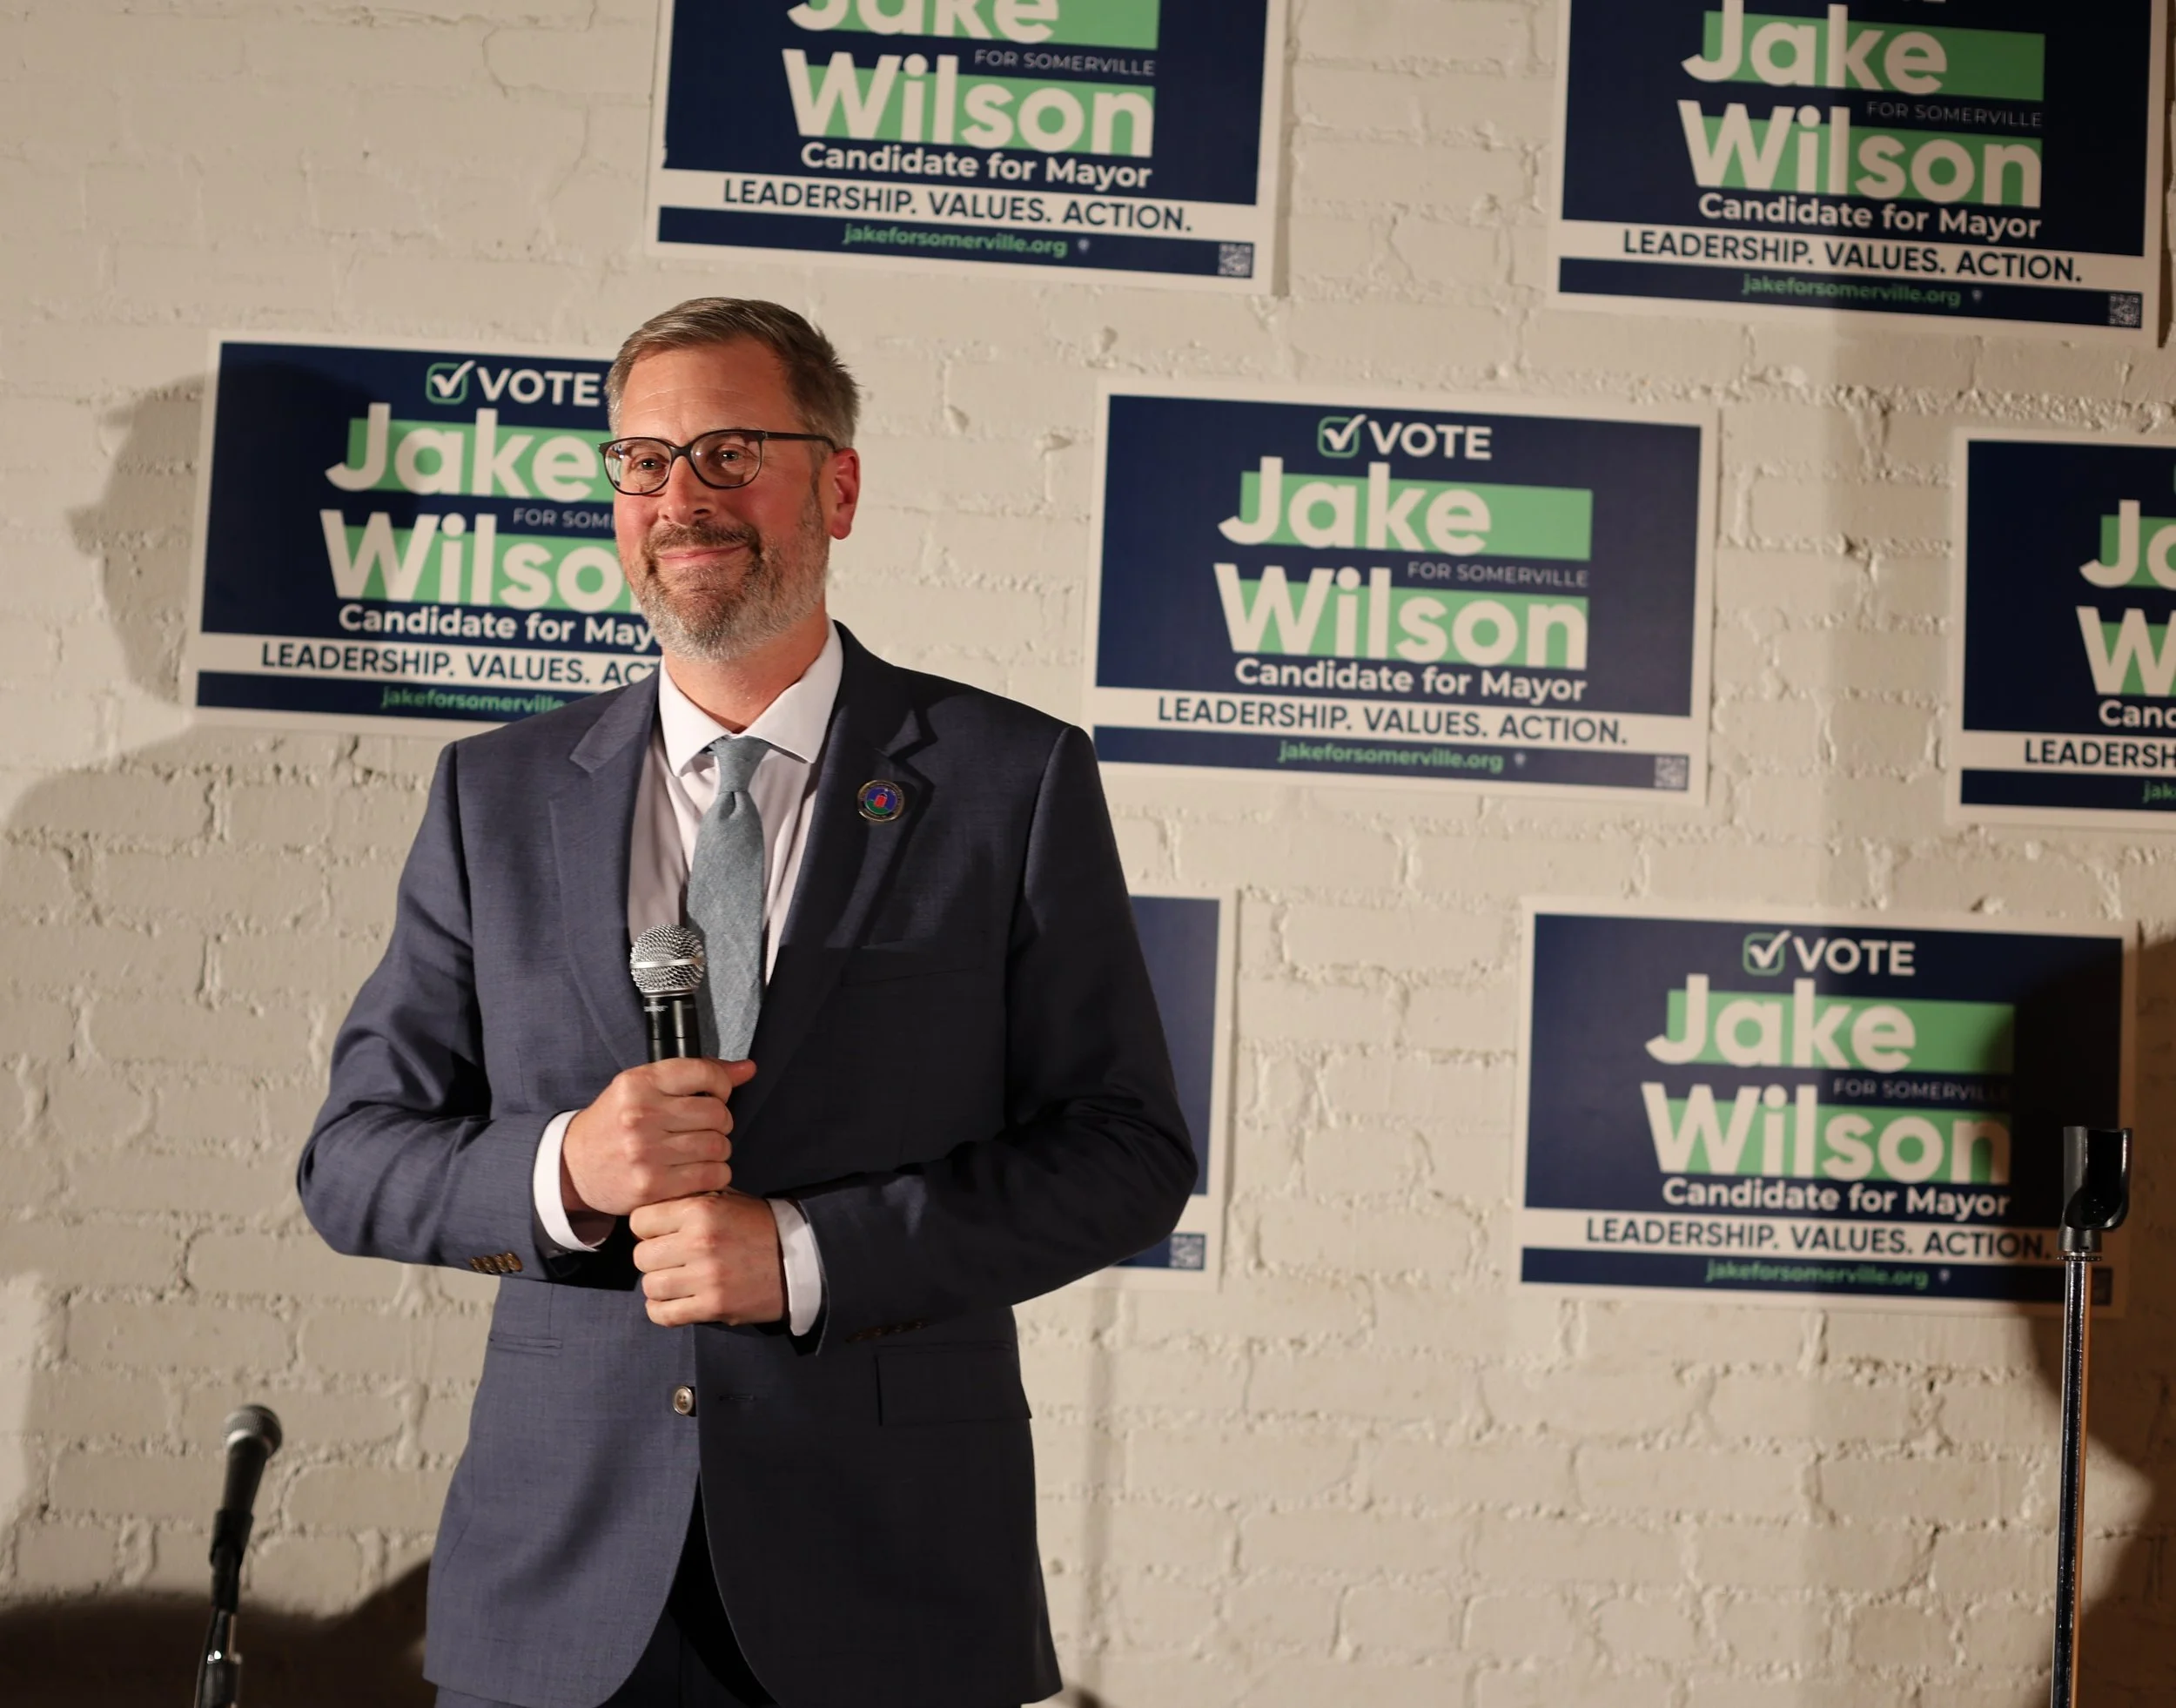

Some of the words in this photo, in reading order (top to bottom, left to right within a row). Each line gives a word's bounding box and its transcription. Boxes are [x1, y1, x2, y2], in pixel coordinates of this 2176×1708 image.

[974, 49, 1017, 68] FOR
[1024, 51, 1156, 77] SOMERVILLE
[1680, 0, 1948, 96] Jake
[782, 49, 1154, 158] Wilson
[1867, 100, 1909, 120] FOR
[1914, 103, 2043, 129] SOMERVILLE
[801, 142, 978, 179] Candidate
[987, 152, 1037, 182] for
[1046, 157, 1153, 192] Mayor
[1677, 99, 2043, 209] Wilson
[723, 178, 917, 215] LEADERSHIP.
[929, 190, 1052, 224] VALUES.
[1063, 199, 1192, 232] ACTION.
[1698, 192, 1873, 228] Candidate
[1882, 202, 1931, 232] for
[1939, 209, 2042, 242] Mayor
[843, 223, 1068, 259] jakeforsomerville.org
[1623, 229, 1813, 265] LEADERSHIP.
[1824, 242, 1946, 274] VALUES.
[1956, 251, 2083, 283] ACTION.
[1742, 273, 1961, 309] jakeforsomerville.org
[477, 366, 601, 407] VOTE
[325, 402, 599, 503] Jake
[1367, 420, 1493, 461] VOTE
[512, 507, 558, 528] FOR
[1218, 455, 1492, 556] Jake
[319, 508, 641, 615] Wilso
[1407, 561, 1452, 581] FOR
[1455, 563, 1589, 588] SOMERVILLE
[339, 603, 517, 640] Candidate
[525, 613, 575, 642] for
[584, 618, 655, 656] May
[1212, 562, 1588, 670] Wilson
[263, 641, 454, 677] LEADERSHIP.
[467, 654, 591, 686] VALUES.
[1234, 657, 1414, 696] Candidate
[1421, 668, 1472, 698] for
[1481, 672, 1588, 706] Mayor
[380, 684, 566, 714] jakeforsomerville
[1158, 696, 1352, 731] LEADERSHIP.
[1363, 707, 1488, 739] VALUES.
[1499, 716, 1629, 746] ACTION.
[1277, 740, 1504, 774] jakeforsomerville.org
[2025, 738, 2176, 769] LEADERSH
[1793, 936, 1916, 976] VOTE
[1644, 973, 1916, 1073] Jake
[1833, 1078, 1877, 1098] FOR
[1642, 1081, 2011, 1185] Wilson
[1662, 1176, 1840, 1214] Candidate
[1849, 1186, 1896, 1214] for
[1906, 1188, 2010, 1223] Mayor
[1587, 1216, 1778, 1251] LEADERSHIP.
[1790, 1226, 1913, 1256] VALUES.
[1923, 1233, 2051, 1262] ACTION.
[1706, 1258, 1929, 1290] jakeforsomerville.org
